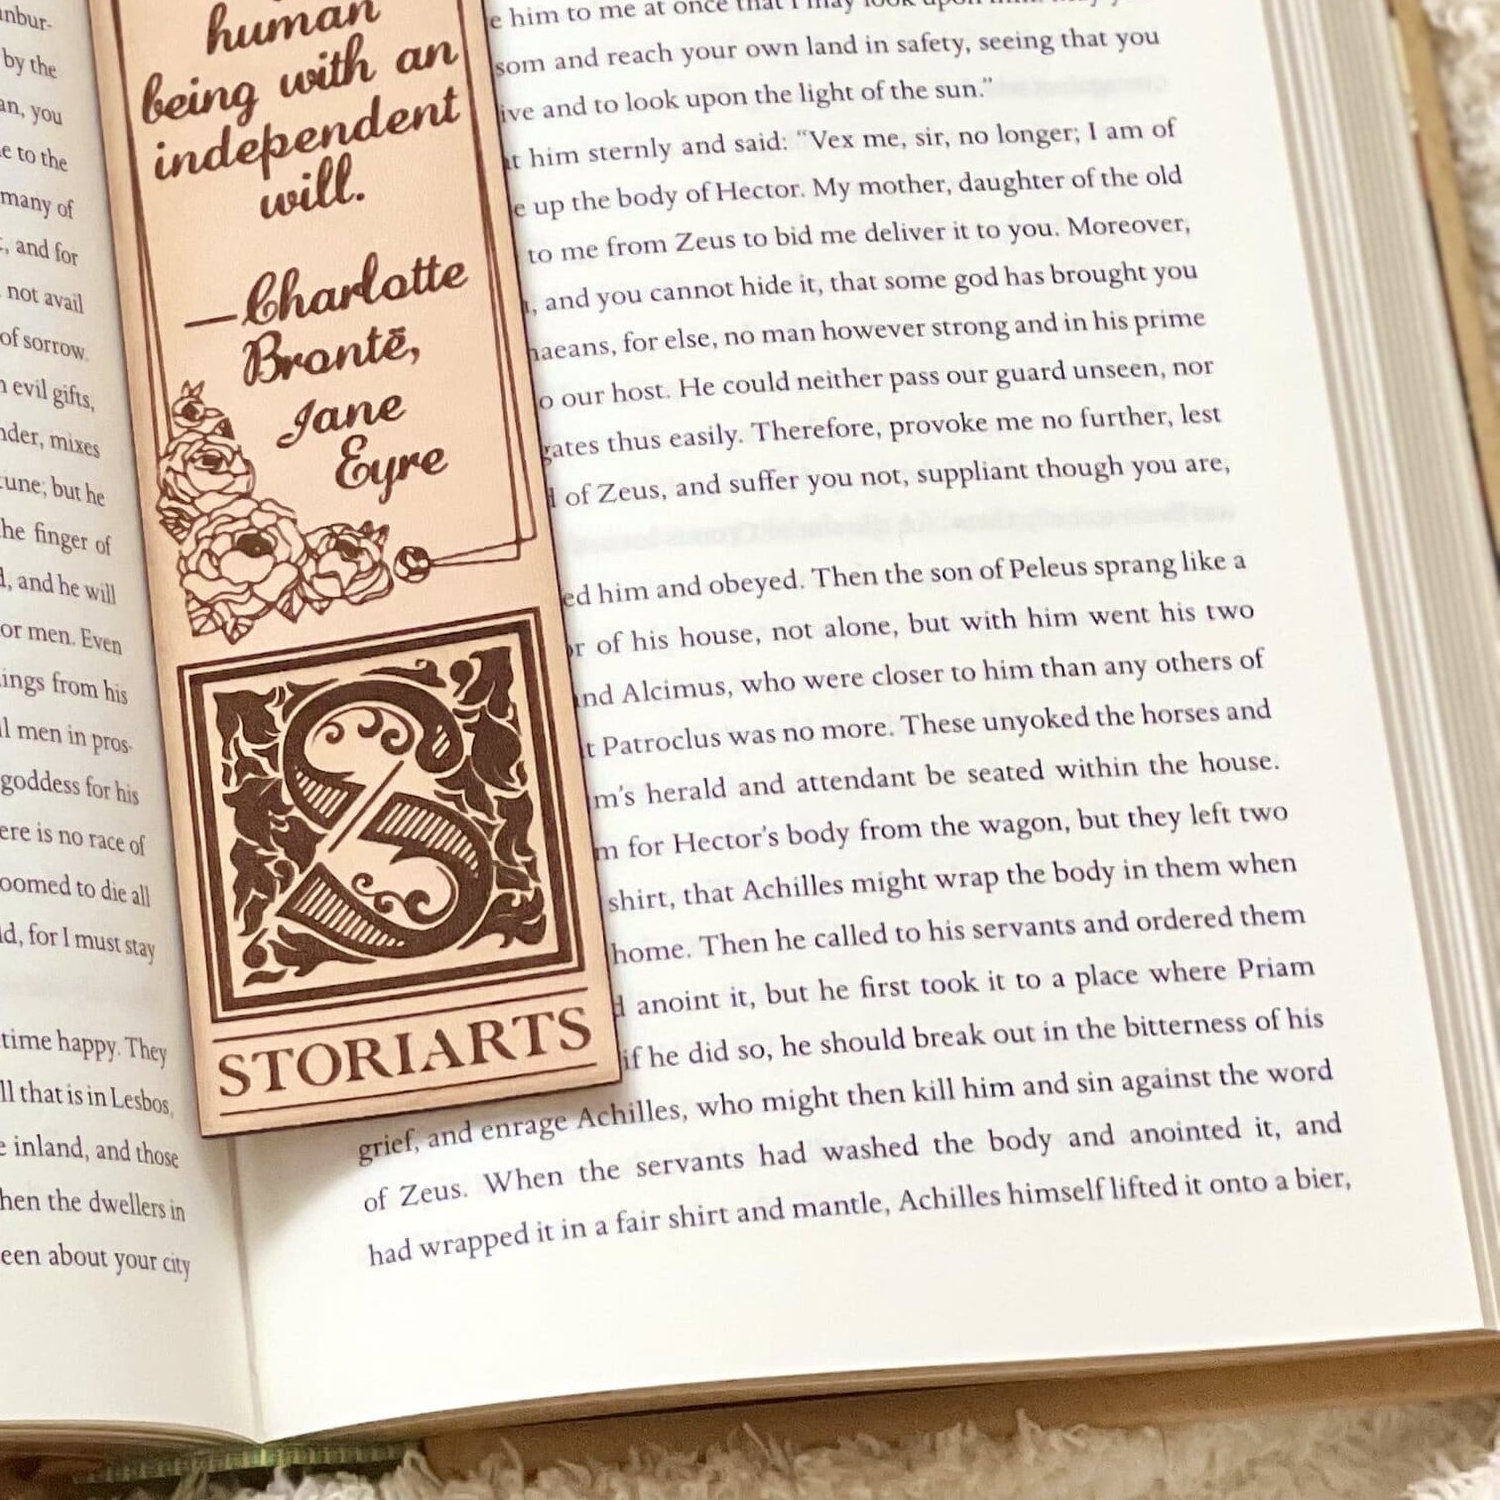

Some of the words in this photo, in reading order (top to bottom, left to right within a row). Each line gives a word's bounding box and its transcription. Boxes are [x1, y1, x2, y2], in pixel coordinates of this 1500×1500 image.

[142, 72, 259, 126] being
[279, 31, 378, 99] with
[395, 38, 458, 71] an
[154, 85, 461, 182] independent
[259, 151, 366, 220] will.
[527, 246, 553, 265] to
[560, 244, 599, 262] me
[606, 235, 668, 258] from
[674, 231, 737, 253] Zeus
[742, 232, 768, 248] to
[773, 223, 814, 247] bid
[820, 229, 857, 245] me
[864, 220, 947, 243] deliver
[952, 220, 970, 241] it
[976, 223, 1001, 240] to
[1007, 222, 1060, 246] you.
[1066, 216, 1191, 237] Moreover,
[275, 394, 407, 450] Jane
[334, 433, 449, 506] Eyre
[16, 724, 63, 744] men
[67, 724, 87, 747] in
[608, 888, 676, 912] shirt,
[683, 882, 735, 906] that
[742, 873, 844, 901] Achilles
[851, 867, 928, 900] might
[933, 870, 1000, 895] wrap
[1006, 861, 1046, 886] the
[1051, 858, 1116, 889] body
[1123, 858, 1149, 881] in
[1154, 855, 1221, 879] them
[1227, 851, 1298, 876] when
[218, 1006, 592, 1098] STORIARTS
[367, 1237, 413, 1267] had
[418, 1220, 530, 1260] wrapped
[536, 1221, 555, 1243] it
[561, 1218, 588, 1240] in
[595, 1220, 609, 1237] a
[616, 1209, 661, 1235] fair
[668, 1203, 730, 1229] shirt
[736, 1195, 786, 1223] and
[791, 1190, 891, 1219] mantle,
[898, 1183, 1002, 1212] Achilles
[1006, 1175, 1106, 1206] himself
[1109, 1172, 1179, 1200] lifted
[1184, 1173, 1203, 1196] it
[1209, 1175, 1268, 1195] onto
[1275, 1175, 1290, 1192] a
[1293, 1166, 1352, 1191] bier,
[47, 1241, 109, 1268] about
[113, 1252, 158, 1277] your
[162, 1252, 191, 1283] city
